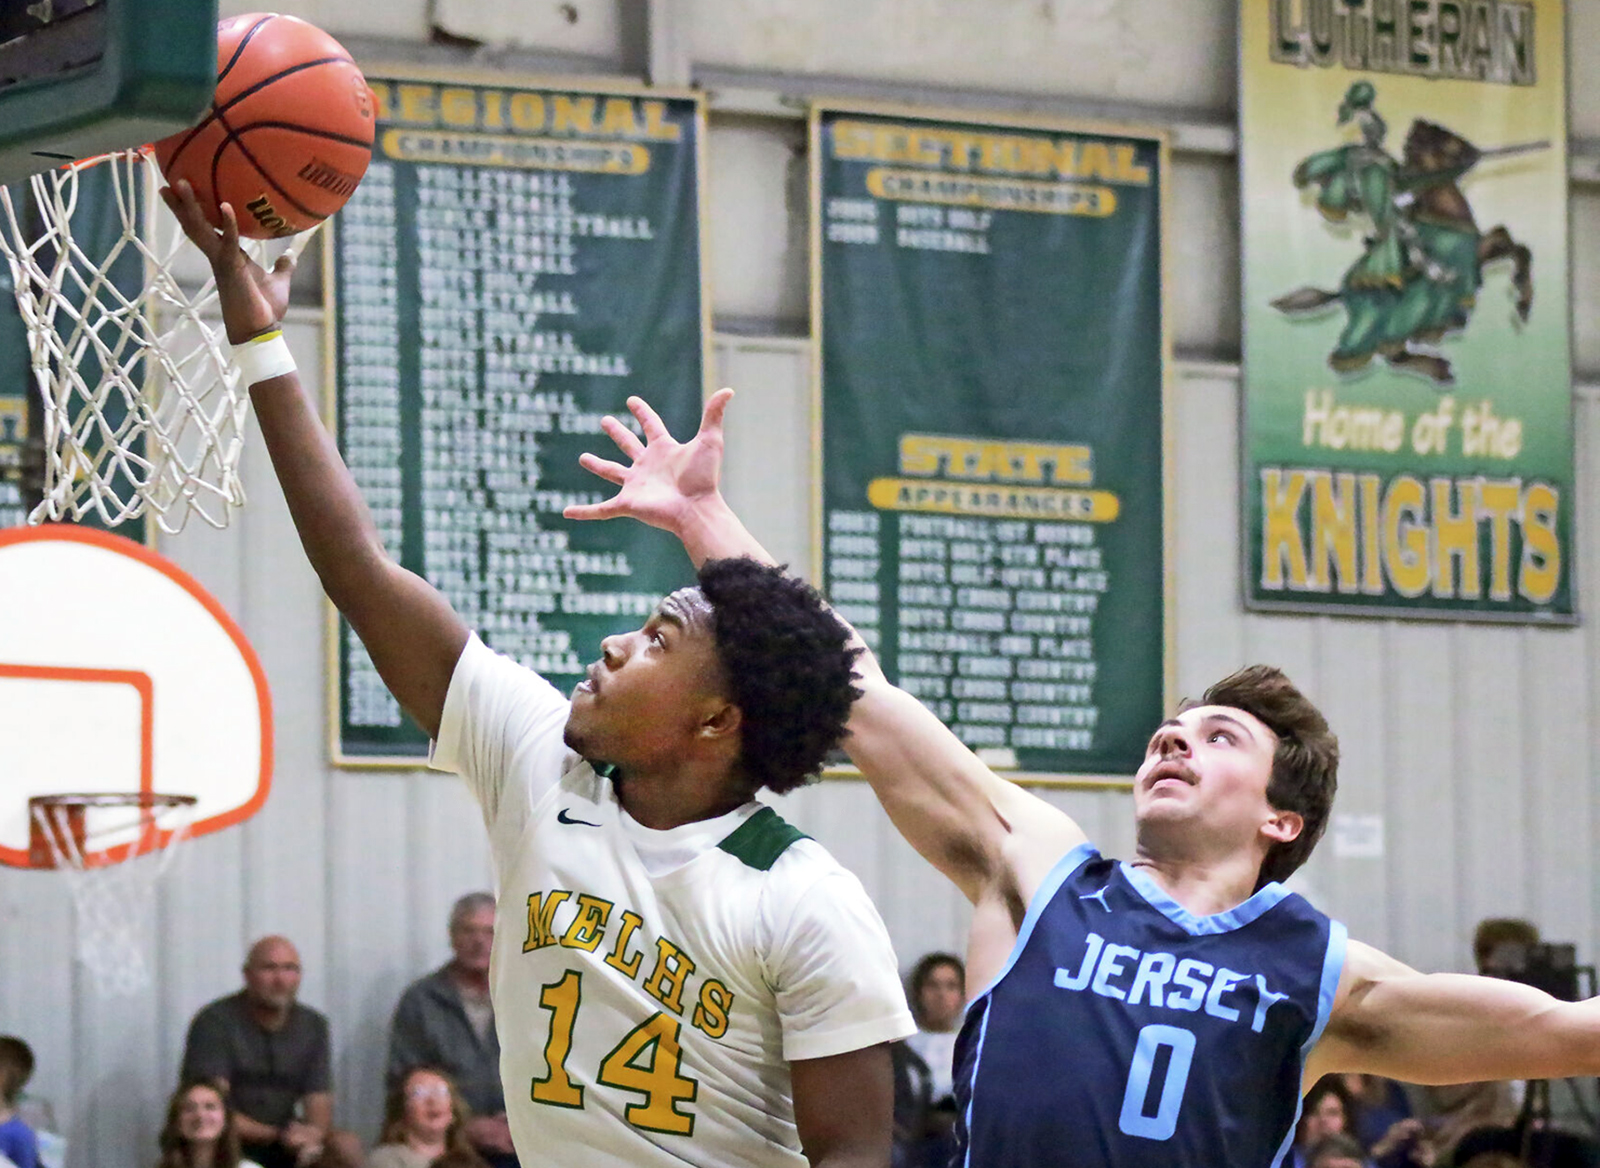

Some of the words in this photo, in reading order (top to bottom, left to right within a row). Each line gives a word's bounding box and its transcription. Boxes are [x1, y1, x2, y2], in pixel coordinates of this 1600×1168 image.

[1269, 0, 1537, 87] LUTHERAN
[396, 132, 634, 170] CHAMPIONSHIPS
[832, 119, 1150, 185] SECTIONAL
[881, 174, 1100, 210] CHAMPIONSHIPS
[899, 432, 1097, 487] STATE
[1302, 388, 1404, 454] Home
[1411, 396, 1456, 456] of
[1461, 398, 1523, 460] the
[898, 483, 1095, 517] APPEARANCES
[1260, 467, 1561, 605] KNIGHTS
[522, 889, 735, 1039] MELHS
[1053, 932, 1290, 1034] JERSEY
[531, 968, 699, 1138] 14
[1118, 1024, 1197, 1141] 0
